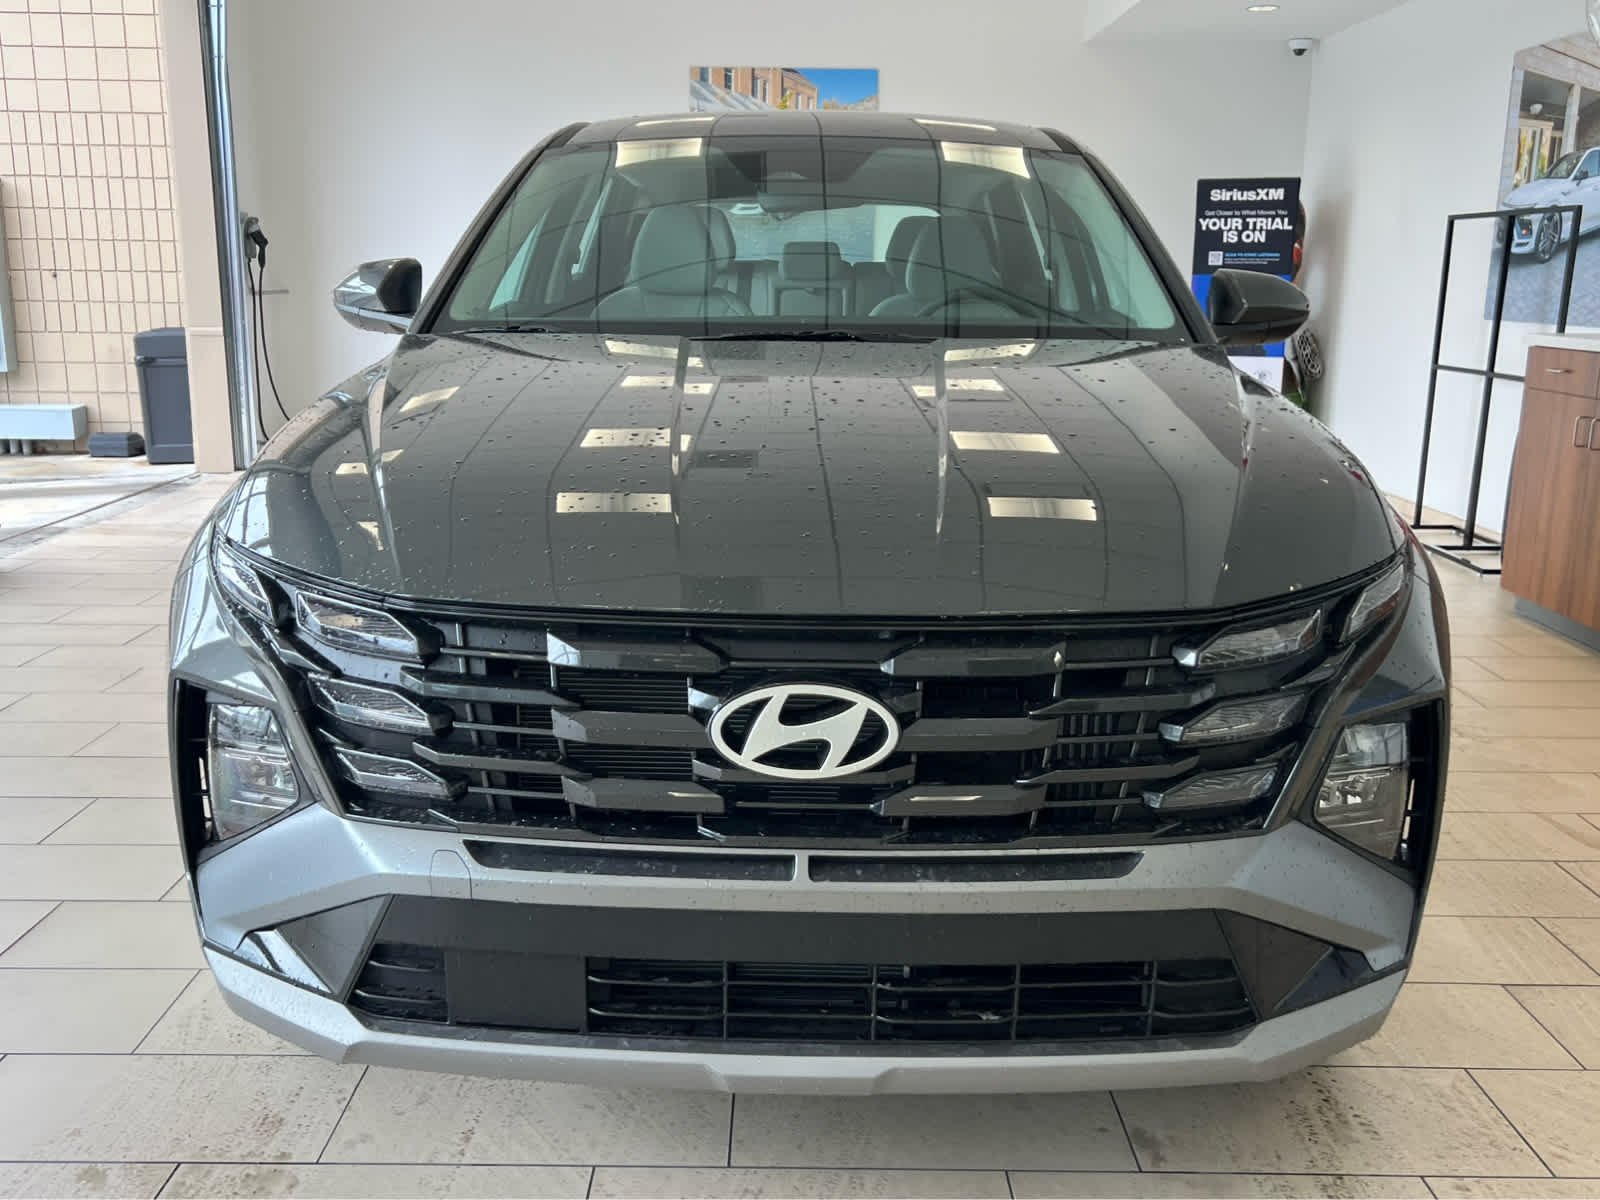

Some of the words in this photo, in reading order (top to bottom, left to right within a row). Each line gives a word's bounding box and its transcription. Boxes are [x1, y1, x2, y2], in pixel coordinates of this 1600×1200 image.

[1210, 188, 1284, 201] SiriusXM
[1199, 218, 1242, 230] YOUR
[1246, 217, 1293, 230] TRIAL
[1223, 231, 1238, 243] IS
[1241, 231, 1266, 243] ON
